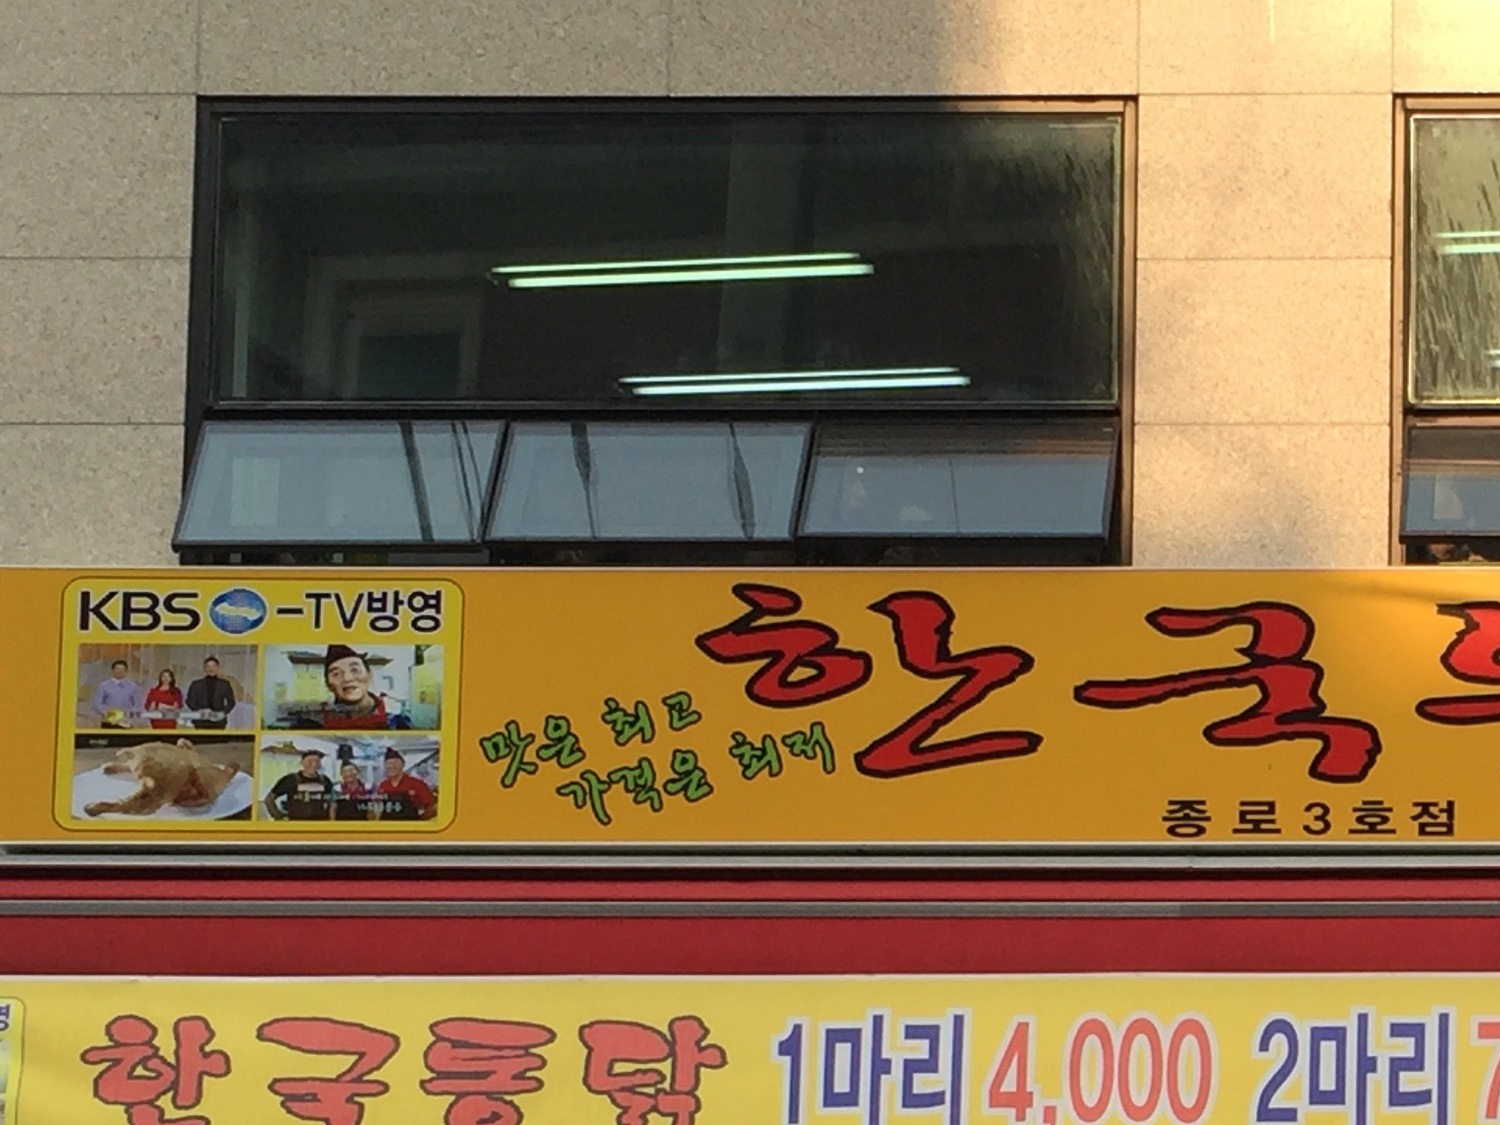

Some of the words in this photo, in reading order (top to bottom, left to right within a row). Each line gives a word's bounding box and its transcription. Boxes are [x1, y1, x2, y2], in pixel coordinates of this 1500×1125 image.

[79, 591, 201, 632] KBS
[479, 715, 586, 789] 맛은
[601, 691, 702, 746] 최고
[556, 749, 714, 826] 가격은
